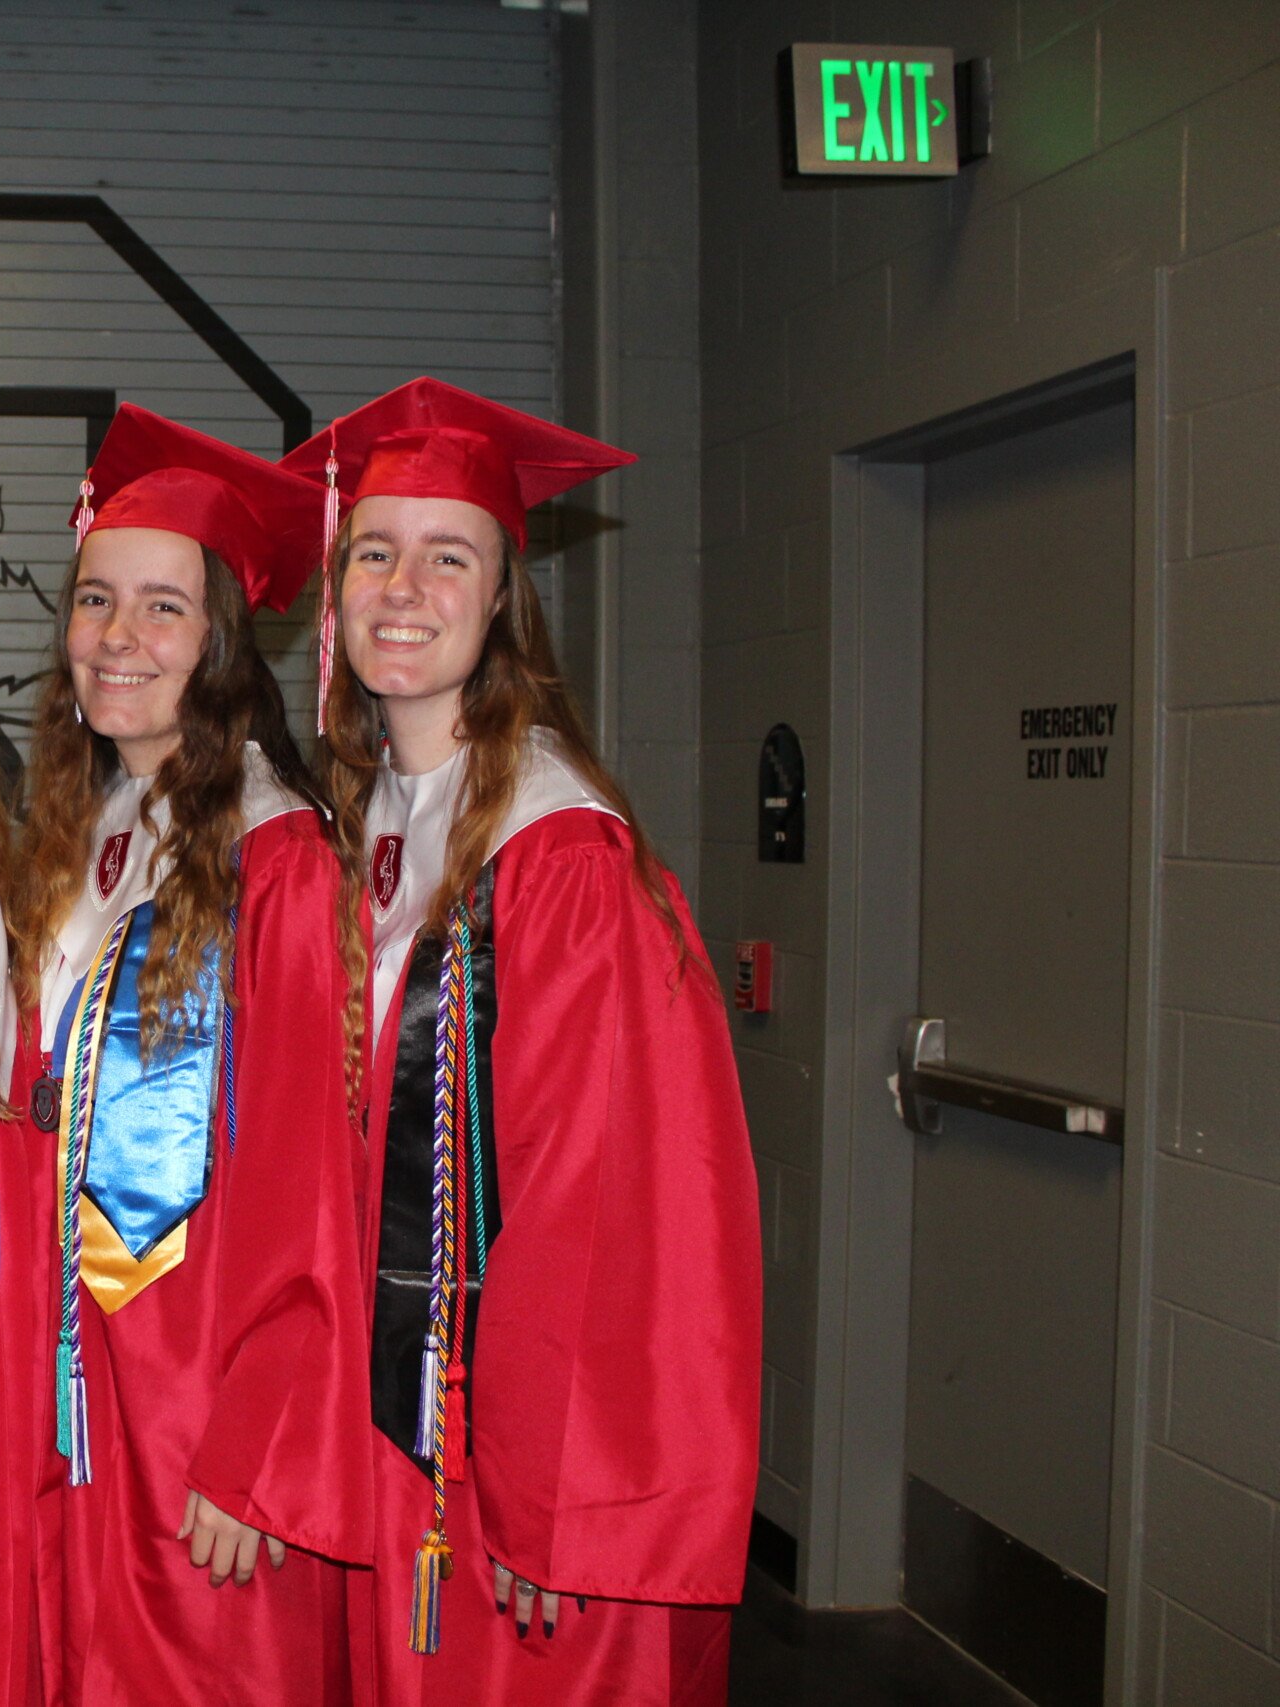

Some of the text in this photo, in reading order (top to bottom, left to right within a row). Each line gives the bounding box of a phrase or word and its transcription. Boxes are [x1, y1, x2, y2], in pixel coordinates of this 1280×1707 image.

[821, 59, 933, 162] EXIT
[1021, 703, 1117, 739] EMERGENCY
[1028, 746, 1108, 779] EXIT ONLY
